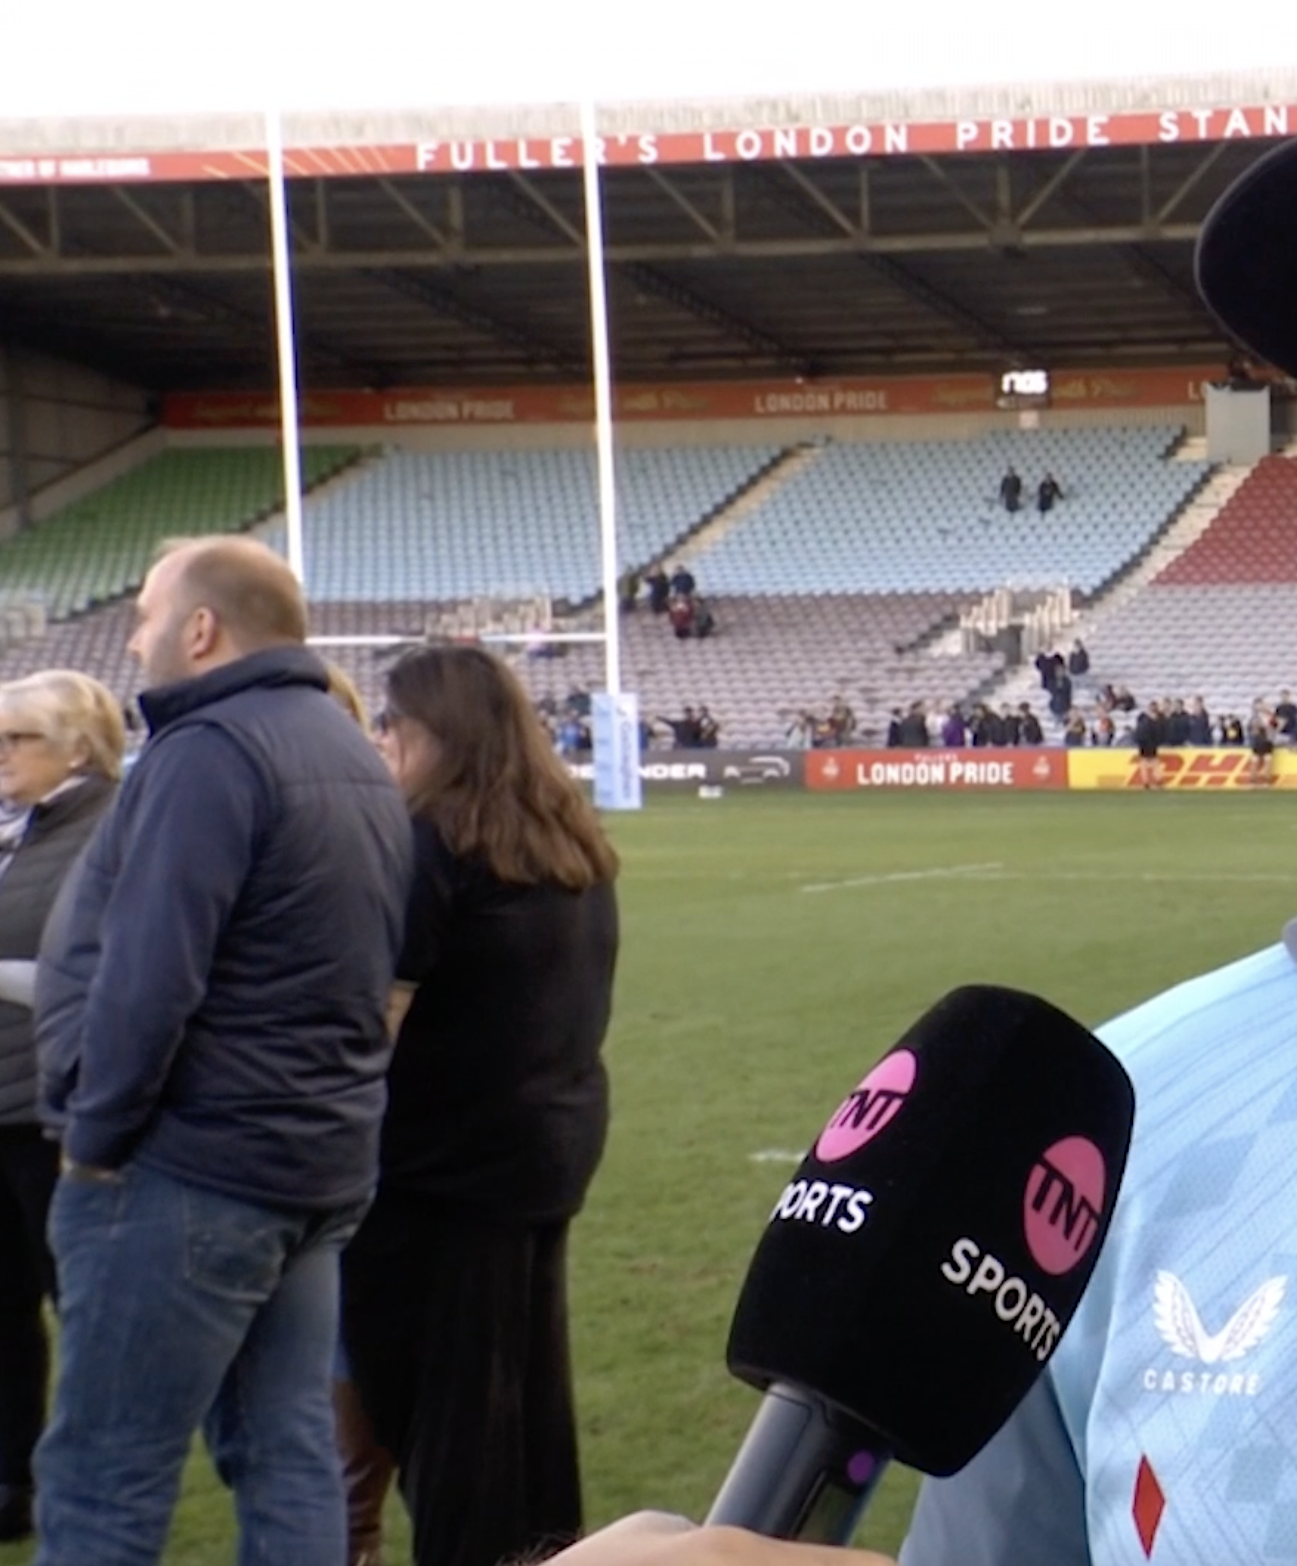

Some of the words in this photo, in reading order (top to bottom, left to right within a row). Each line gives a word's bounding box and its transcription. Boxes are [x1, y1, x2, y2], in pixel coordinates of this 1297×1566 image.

[704, 125, 908, 161] LONDON
[957, 115, 1110, 149] PRIDE
[755, 393, 831, 413] LONDON
[833, 391, 888, 410] PRIDE
[857, 762, 945, 785] LONDON
[950, 761, 1014, 784] PRIDE
[1128, 754, 1282, 786] DHL
[1032, 1156, 1100, 1253] TNT
[941, 1236, 1061, 1362] SPORTS
[1144, 1368, 1261, 1396] CASTORE
